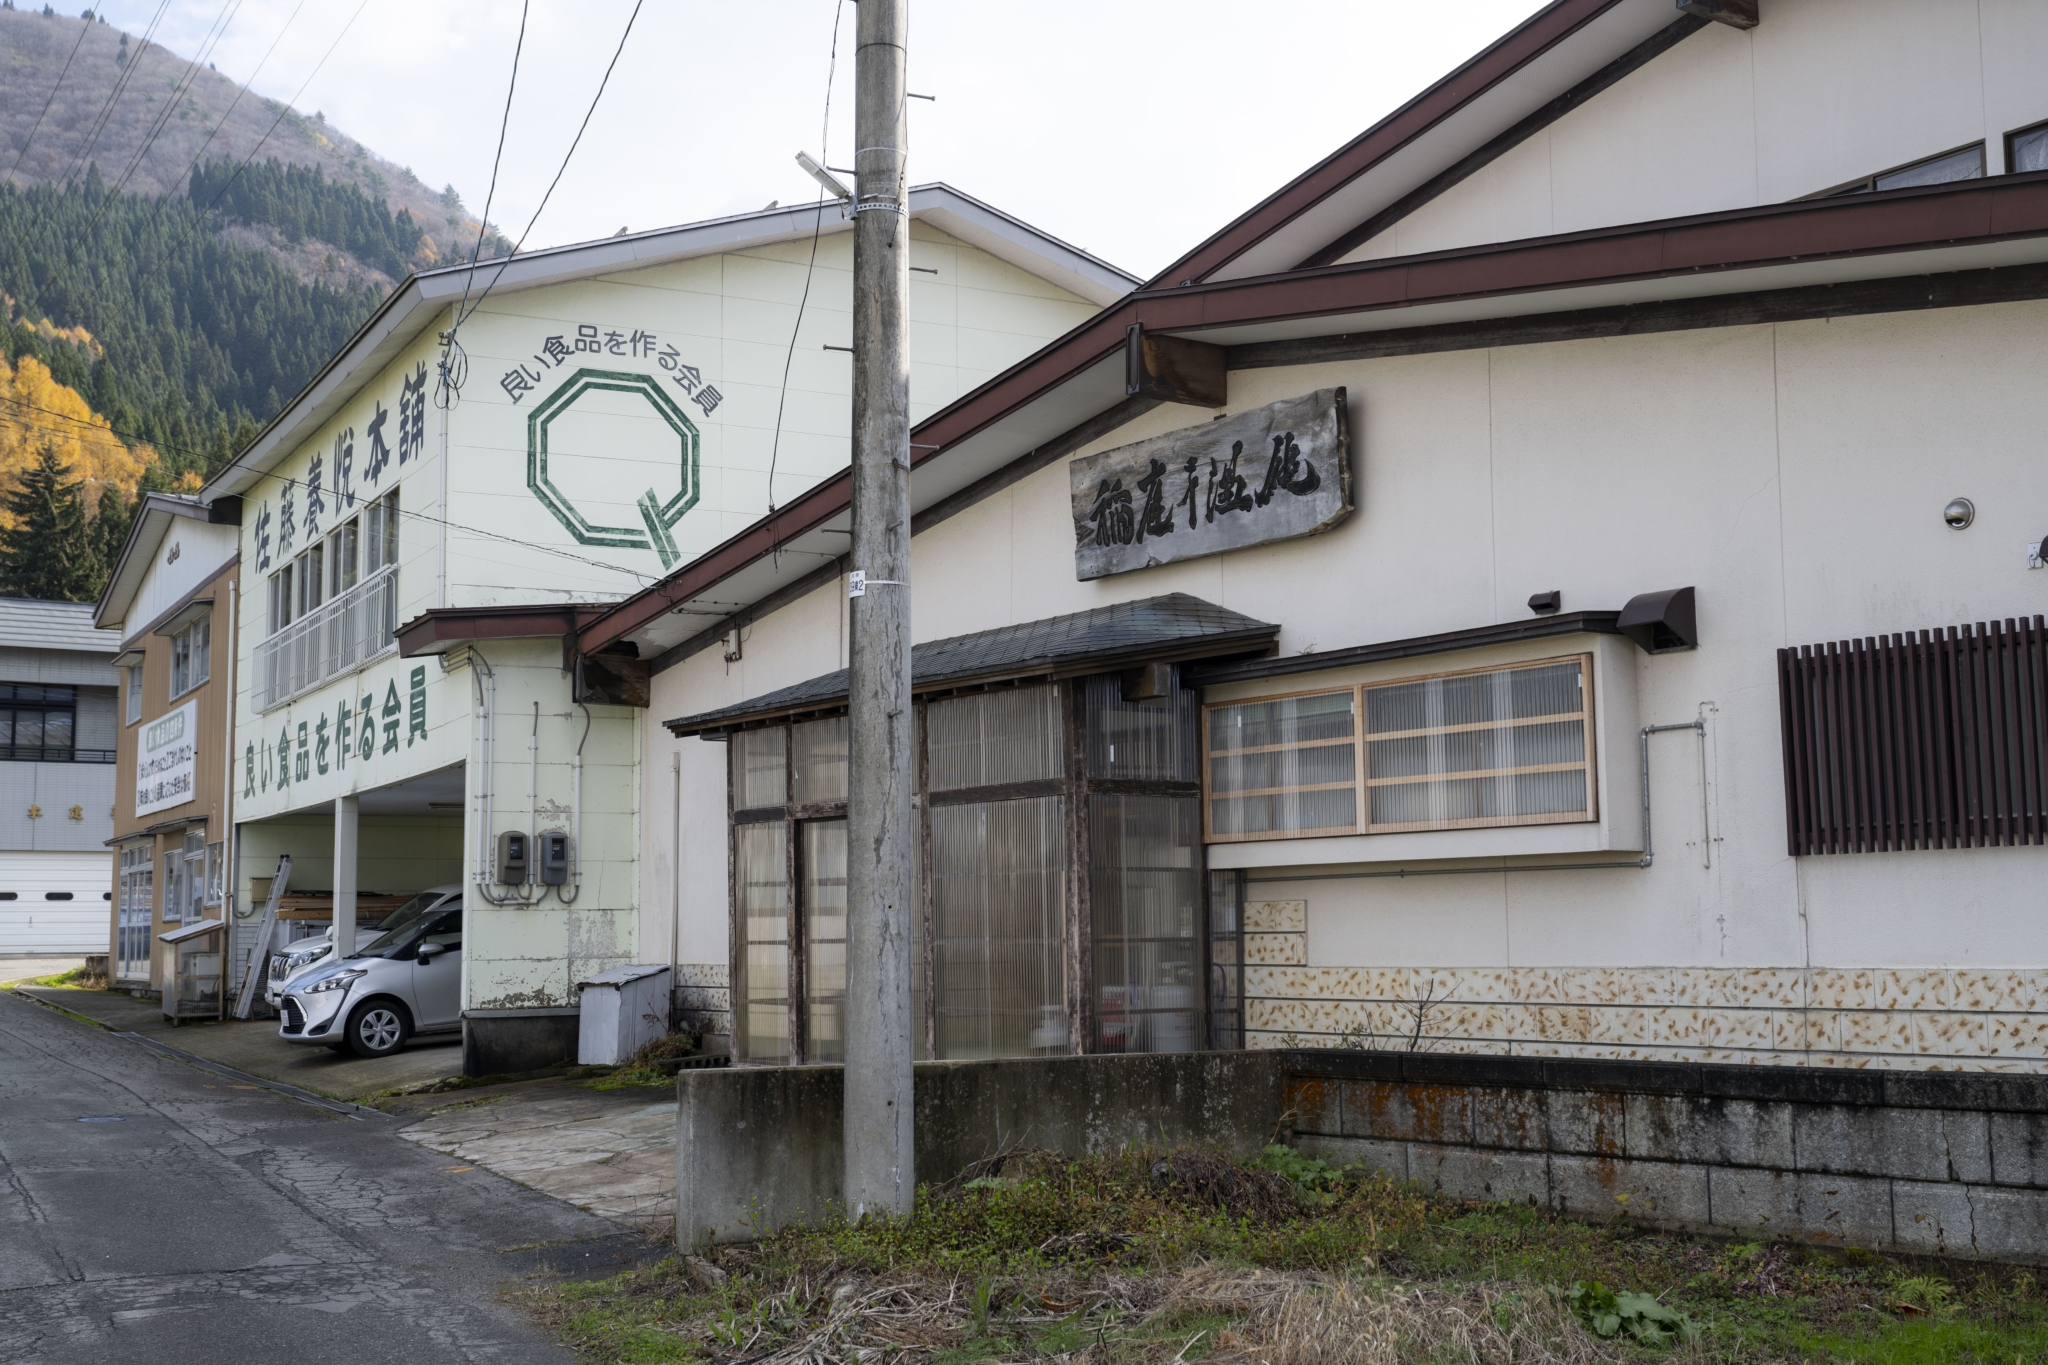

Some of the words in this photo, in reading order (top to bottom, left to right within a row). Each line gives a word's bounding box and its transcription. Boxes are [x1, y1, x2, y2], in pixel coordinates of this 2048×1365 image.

[500, 324, 724, 418] 良い食品を作る会員
[254, 359, 428, 575] 佐藤養悦本舗
[243, 664, 428, 800] 良い食品を作る会員
